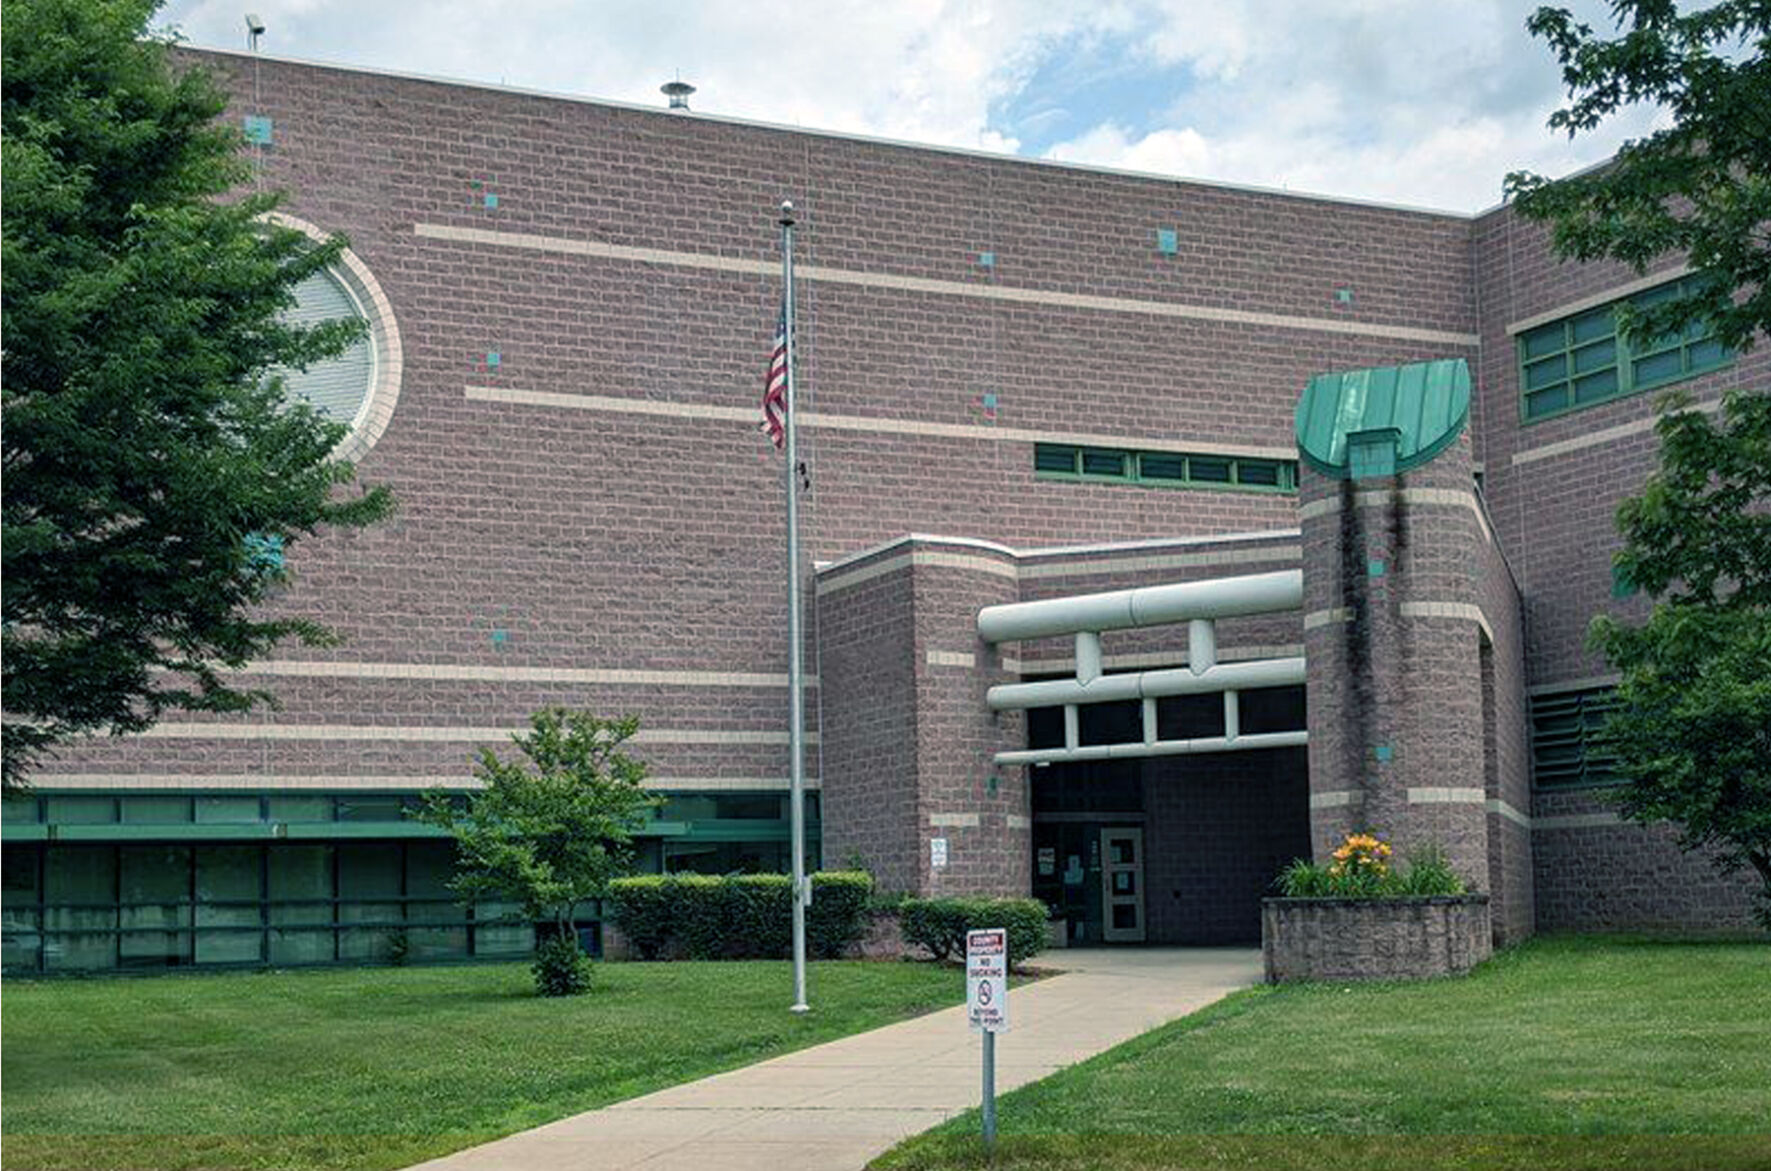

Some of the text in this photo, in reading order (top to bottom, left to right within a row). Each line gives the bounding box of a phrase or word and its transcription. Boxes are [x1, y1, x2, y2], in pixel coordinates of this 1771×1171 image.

[973, 935, 999, 946] COUNTY
[980, 958, 990, 966] NO
[970, 968, 1003, 978] SMOKING
